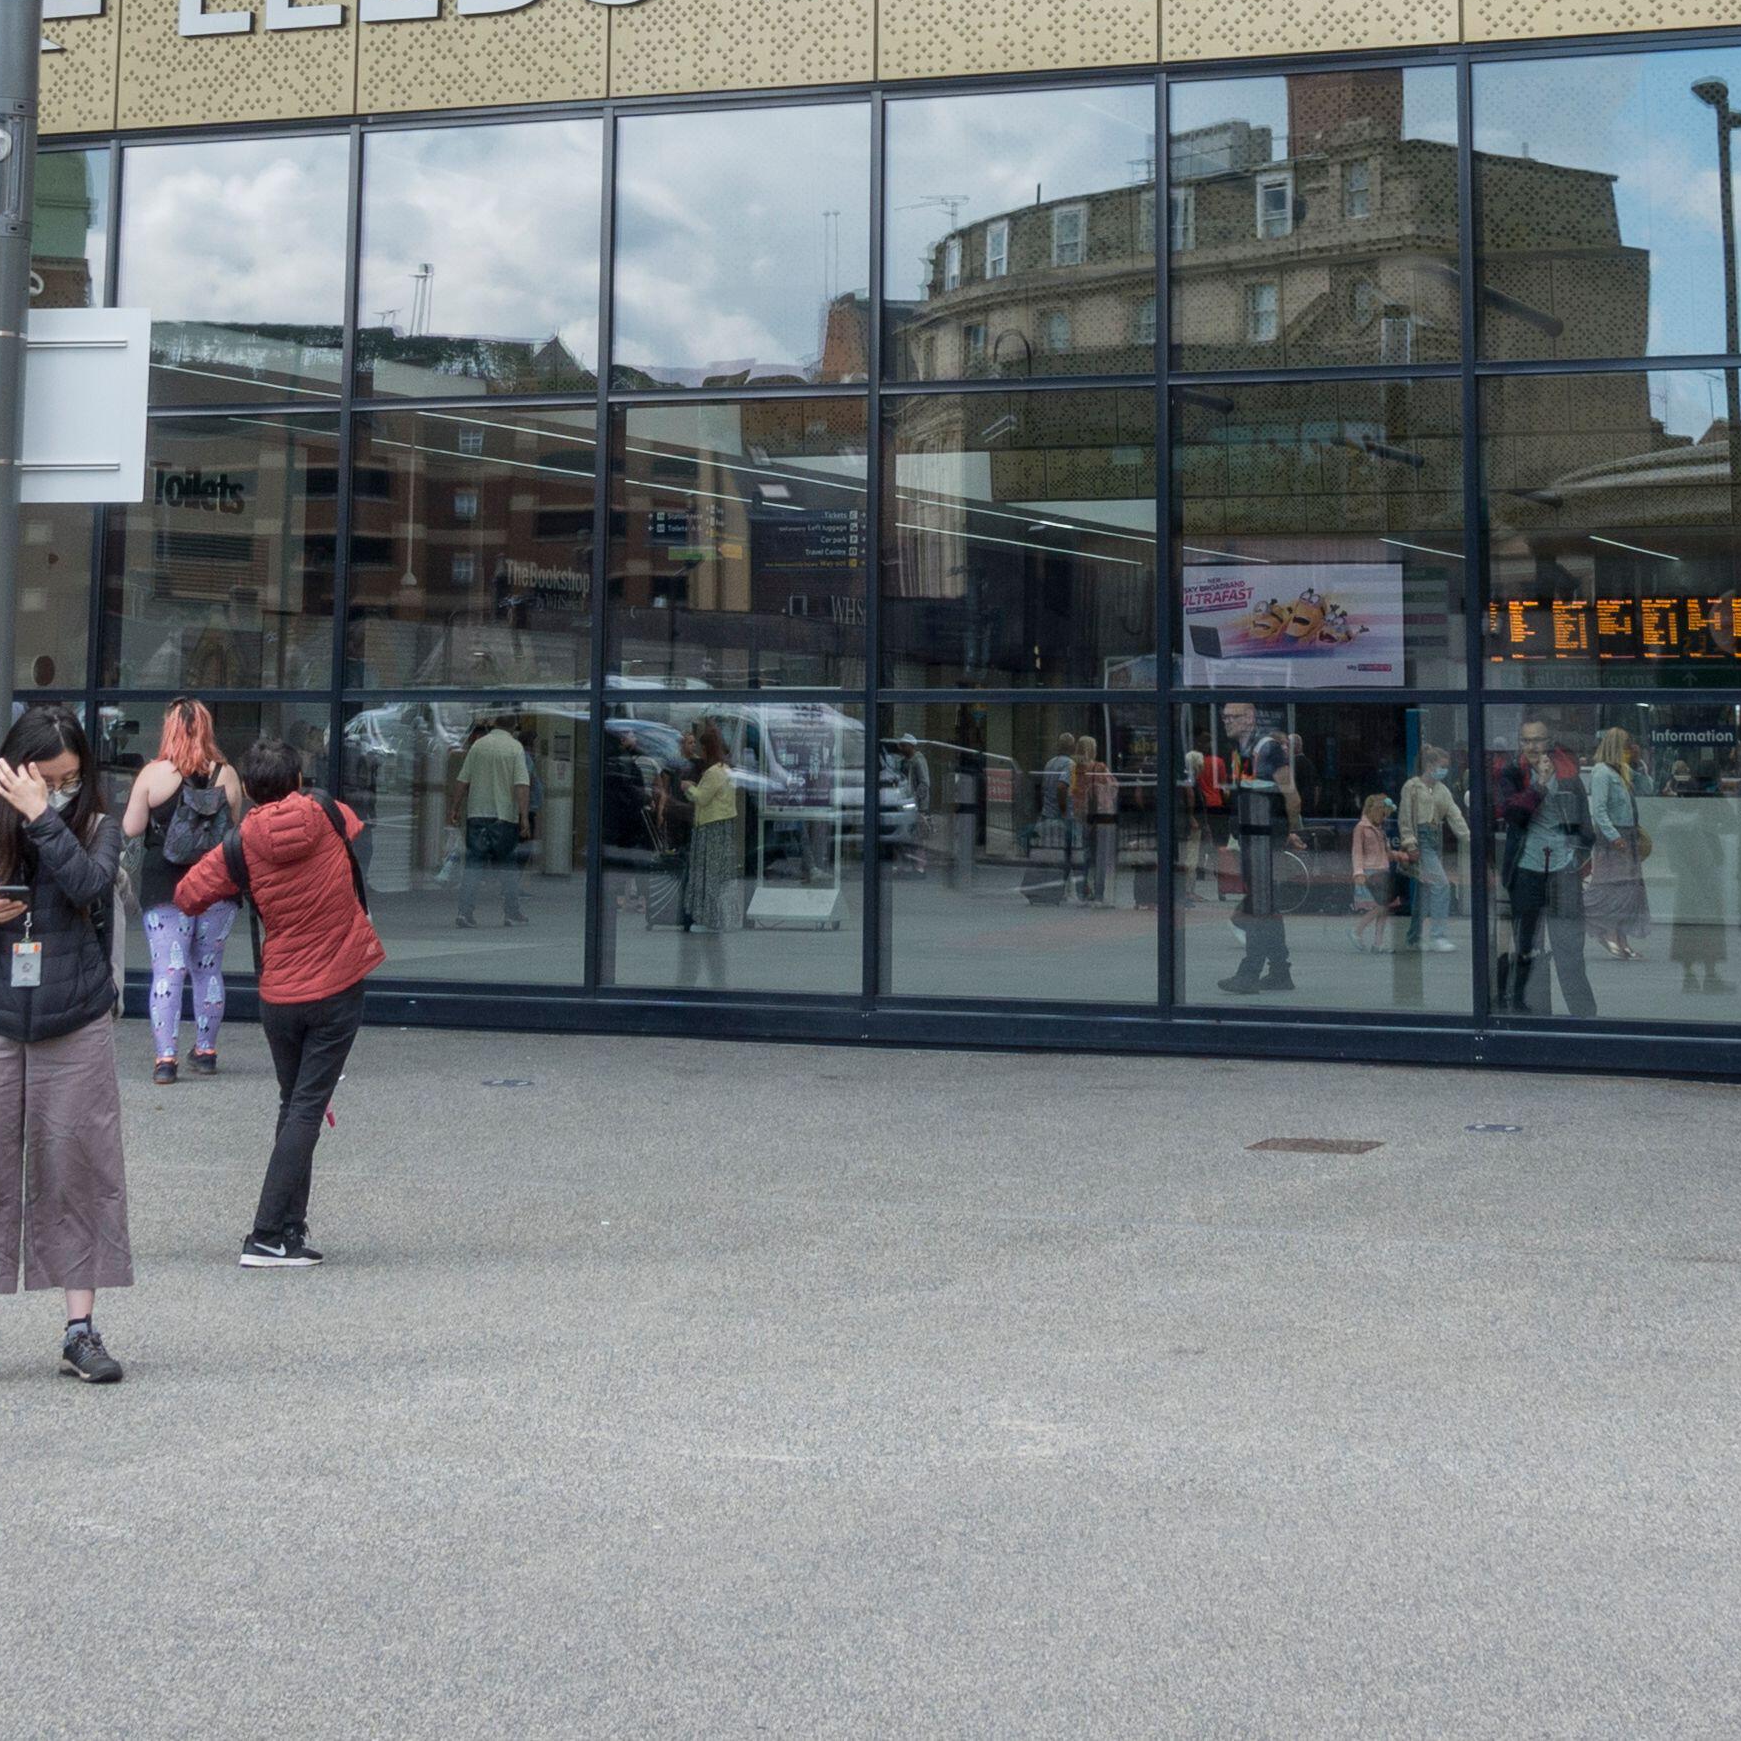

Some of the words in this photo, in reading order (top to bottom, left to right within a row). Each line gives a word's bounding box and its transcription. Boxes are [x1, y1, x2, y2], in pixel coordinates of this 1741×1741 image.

[148, 460, 246, 515] Toilets
[831, 595, 867, 625] WHS
[1651, 729, 1734, 743] Information
